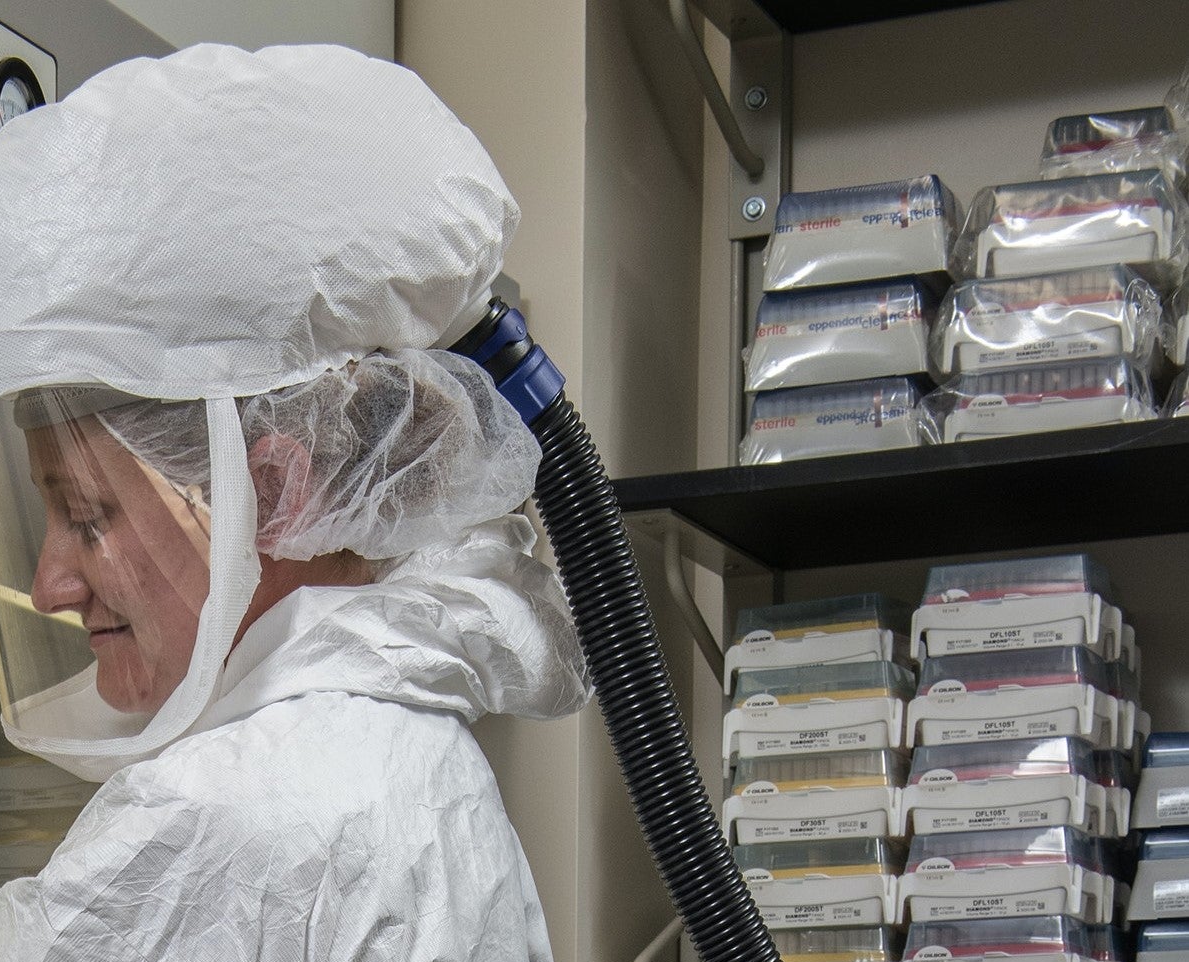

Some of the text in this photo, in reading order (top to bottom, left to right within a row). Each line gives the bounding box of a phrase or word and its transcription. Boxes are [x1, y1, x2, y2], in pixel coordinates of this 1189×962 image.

[799, 217, 842, 232] sterile
[754, 416, 796, 431] sterile
[990, 630, 1021, 639] DFL10ST
[984, 721, 1015, 729] DFL10ST
[799, 731, 829, 739] DF200ST
[975, 809, 1007, 818] DFL10ST
[800, 819, 827, 827] DF30ST
[973, 898, 1004, 906] DFL10ST
